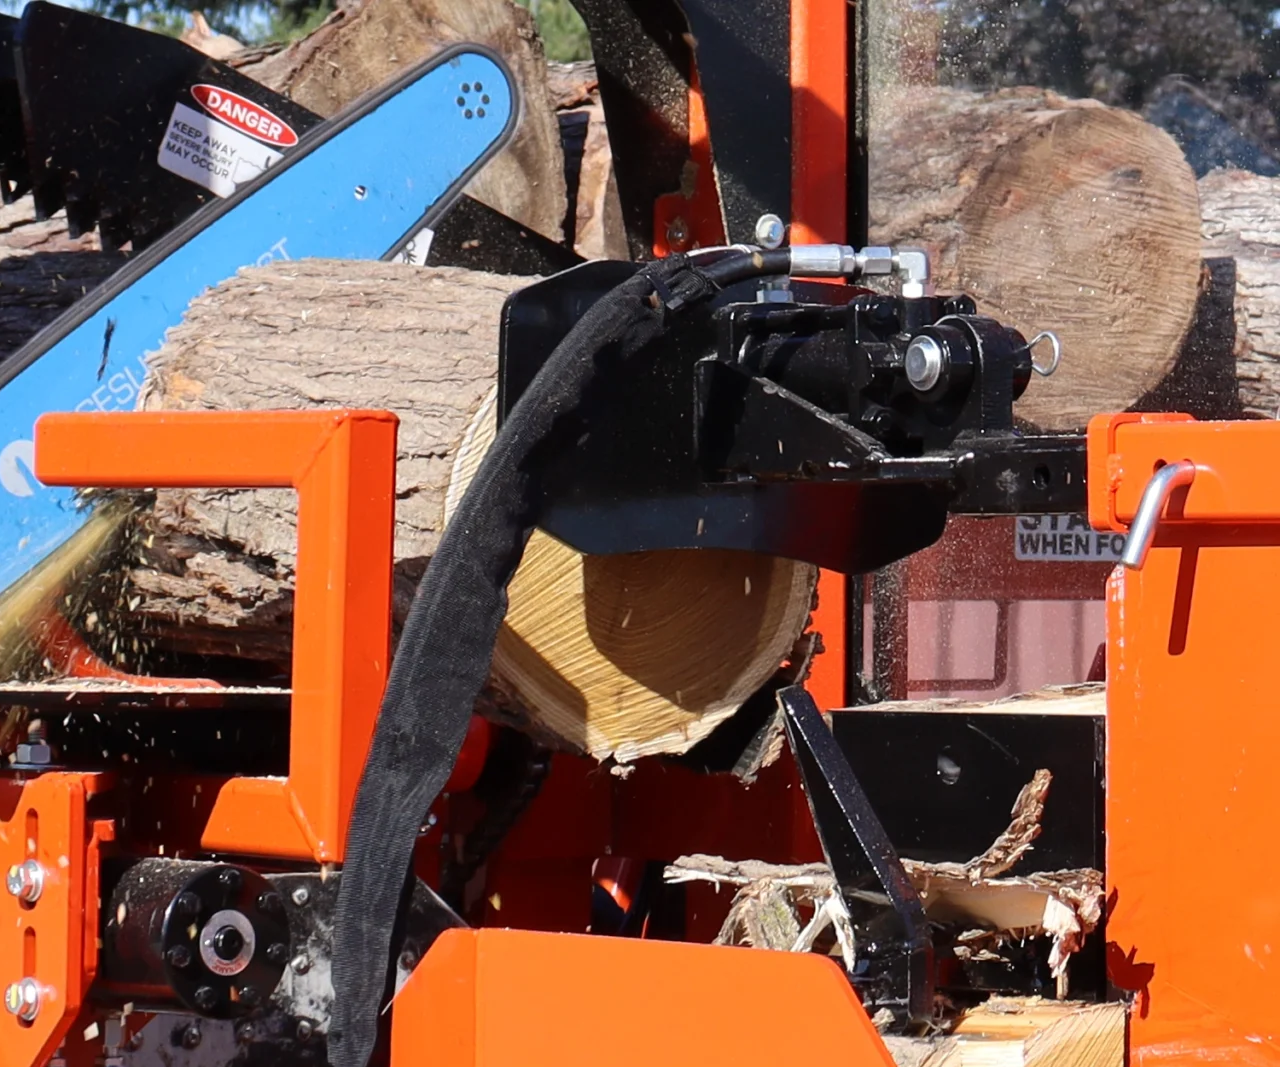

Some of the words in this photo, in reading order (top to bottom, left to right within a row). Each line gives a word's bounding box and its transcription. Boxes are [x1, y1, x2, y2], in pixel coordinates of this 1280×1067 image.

[207, 90, 282, 141] DANGER
[169, 131, 201, 153] SEVERE
[202, 147, 233, 167] INJURY
[173, 120, 203, 139] KEEP
[203, 135, 236, 157] AWAY
[166, 141, 190, 159] MAY
[191, 154, 229, 179] OCCUR
[1019, 533, 1090, 555] WHEN
[1096, 534, 1126, 556] FO
